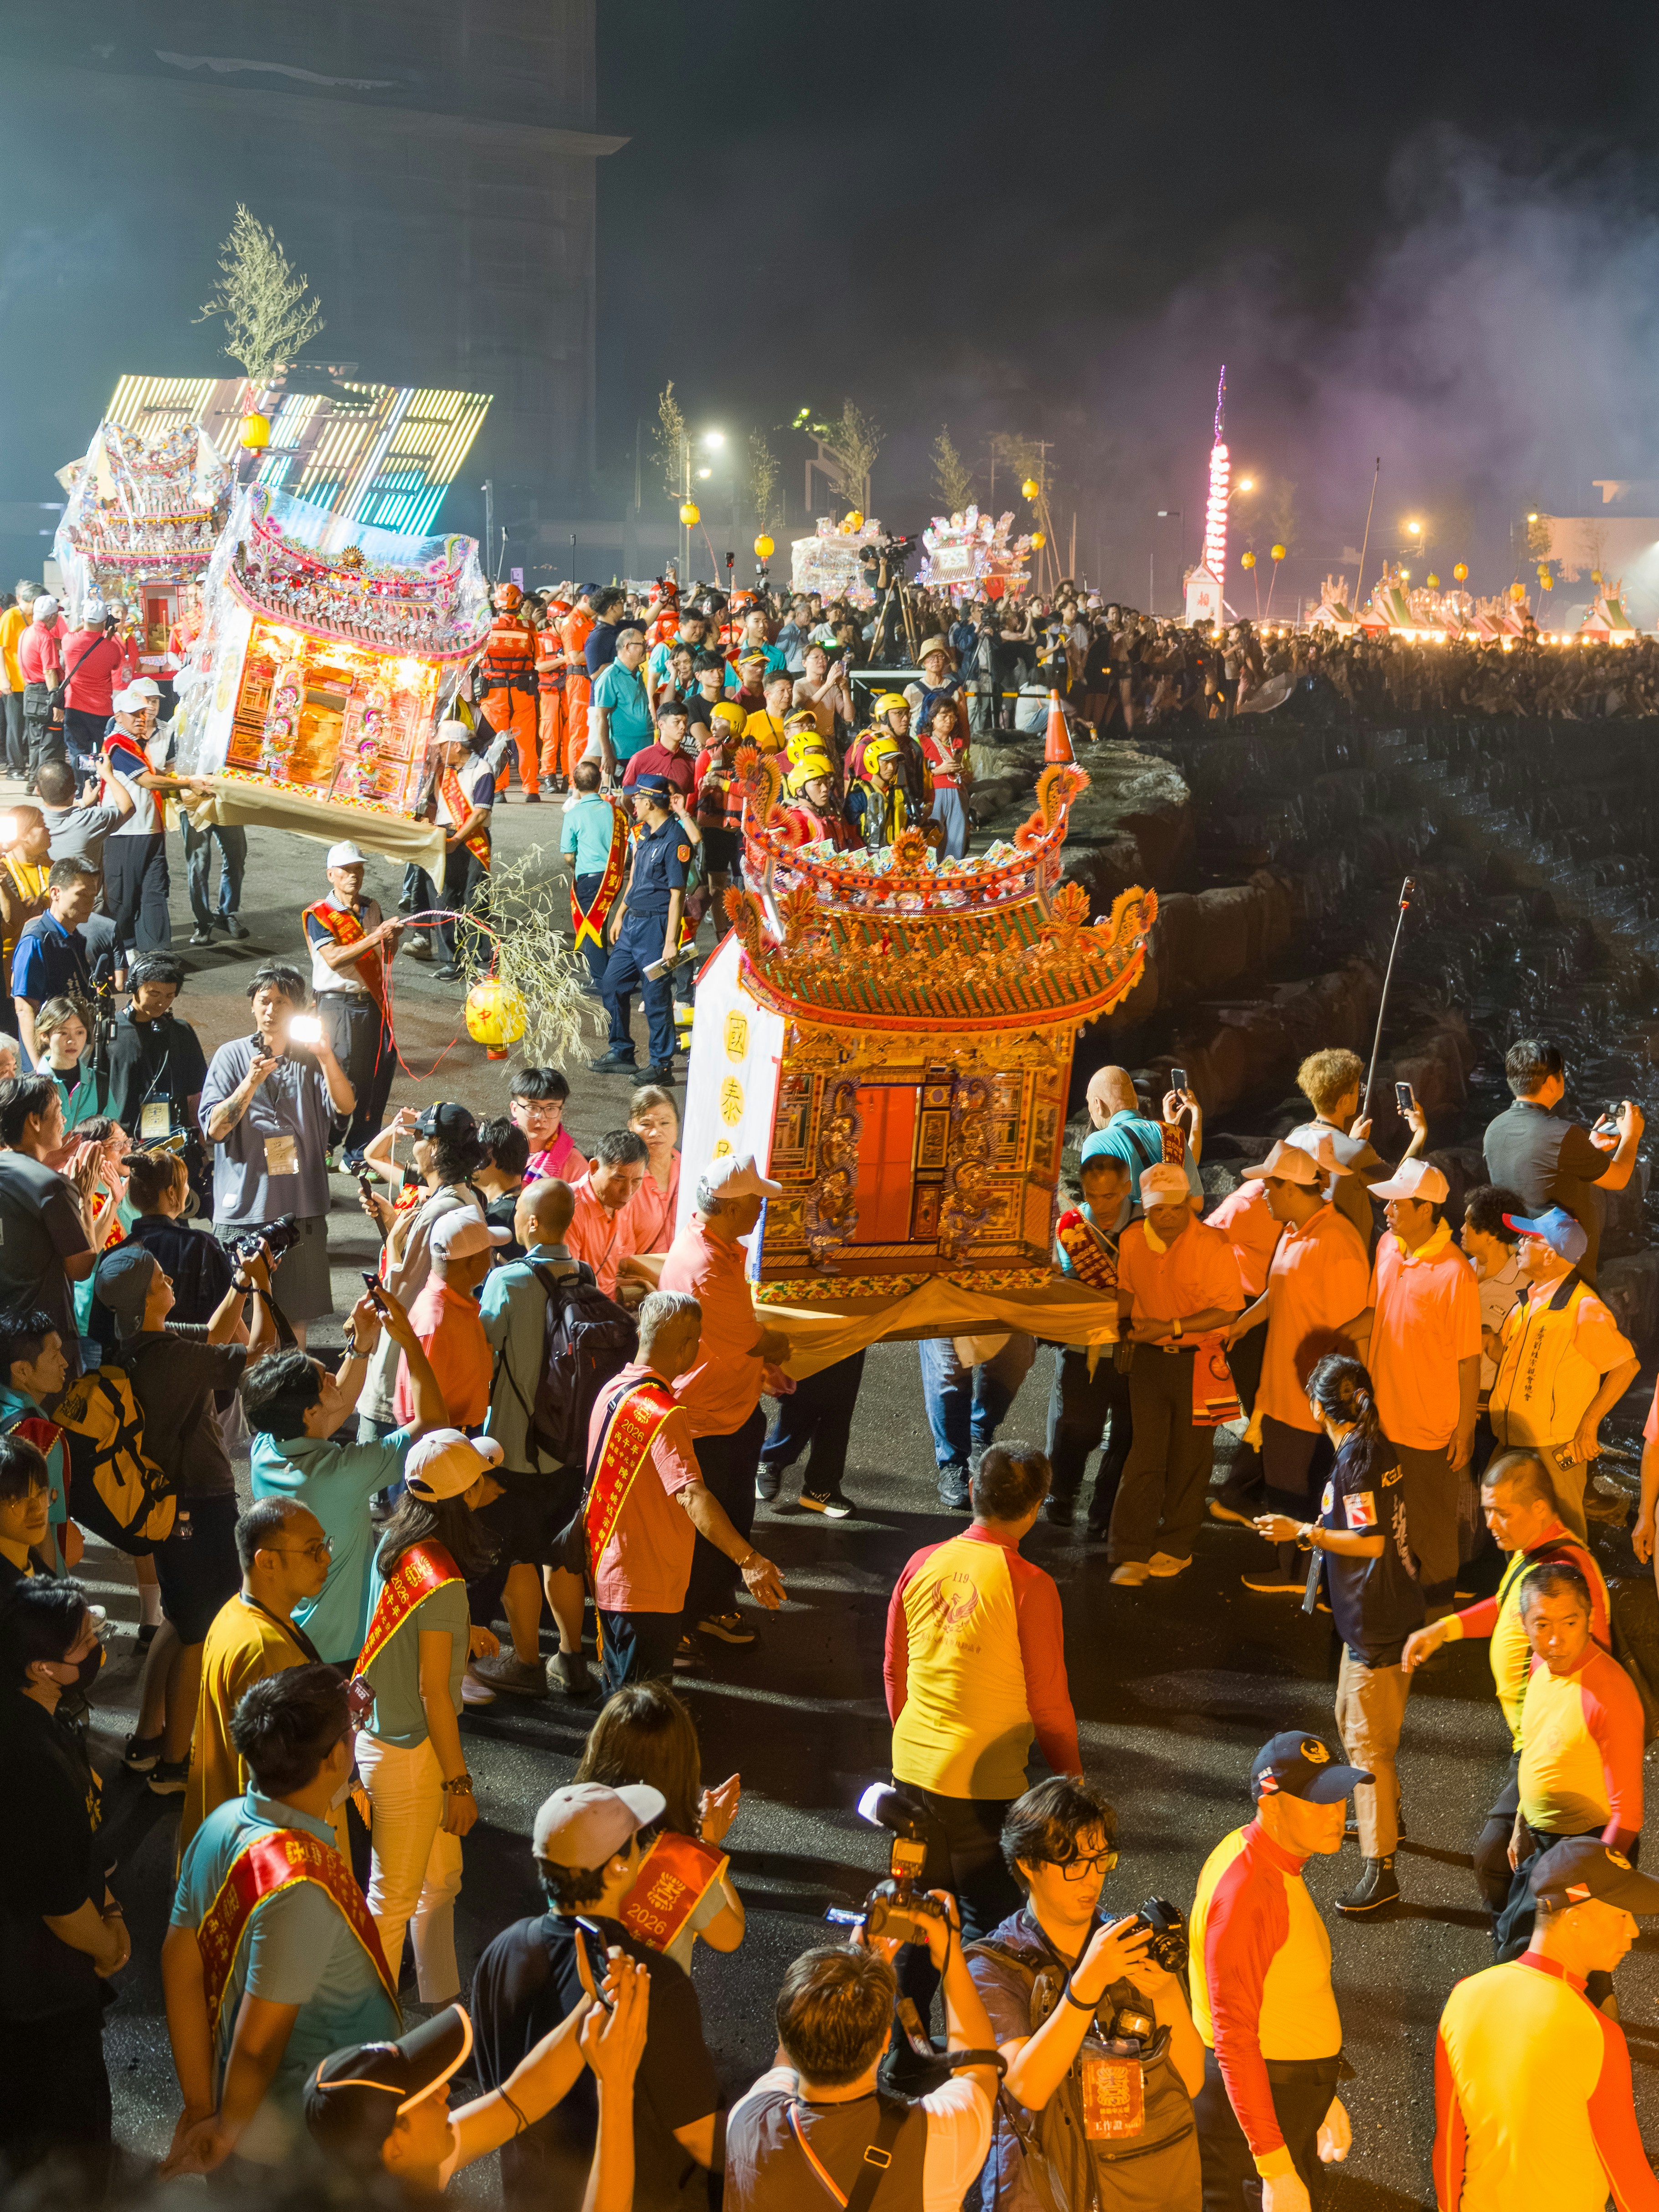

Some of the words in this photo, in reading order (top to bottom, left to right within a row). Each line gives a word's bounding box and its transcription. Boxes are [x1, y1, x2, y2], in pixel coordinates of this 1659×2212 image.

[621, 1419, 644, 1442] 2026
[614, 1431, 639, 1455] 丙午年
[391, 1573, 409, 1604] 2026
[952, 1571, 970, 1584] 119
[627, 1903, 667, 1935] 2026
